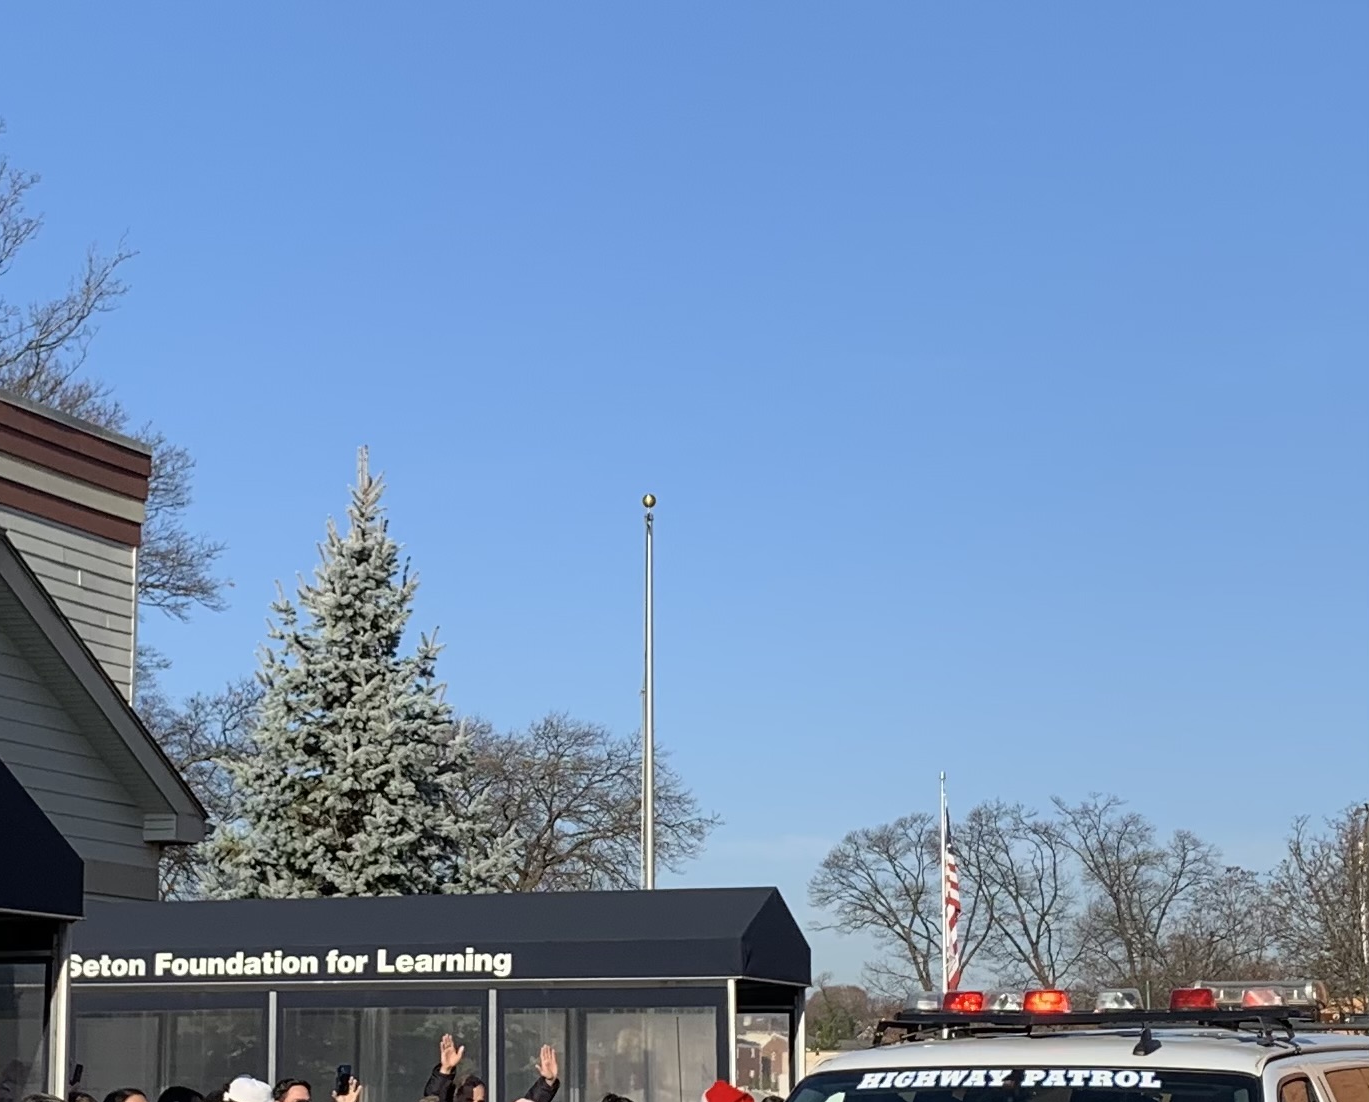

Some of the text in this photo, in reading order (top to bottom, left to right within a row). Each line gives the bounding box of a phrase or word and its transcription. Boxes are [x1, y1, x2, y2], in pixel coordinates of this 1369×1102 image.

[70, 947, 512, 977] Seton Foundation for Learning
[857, 1069, 1162, 1090] HIGHWAY PATROL
